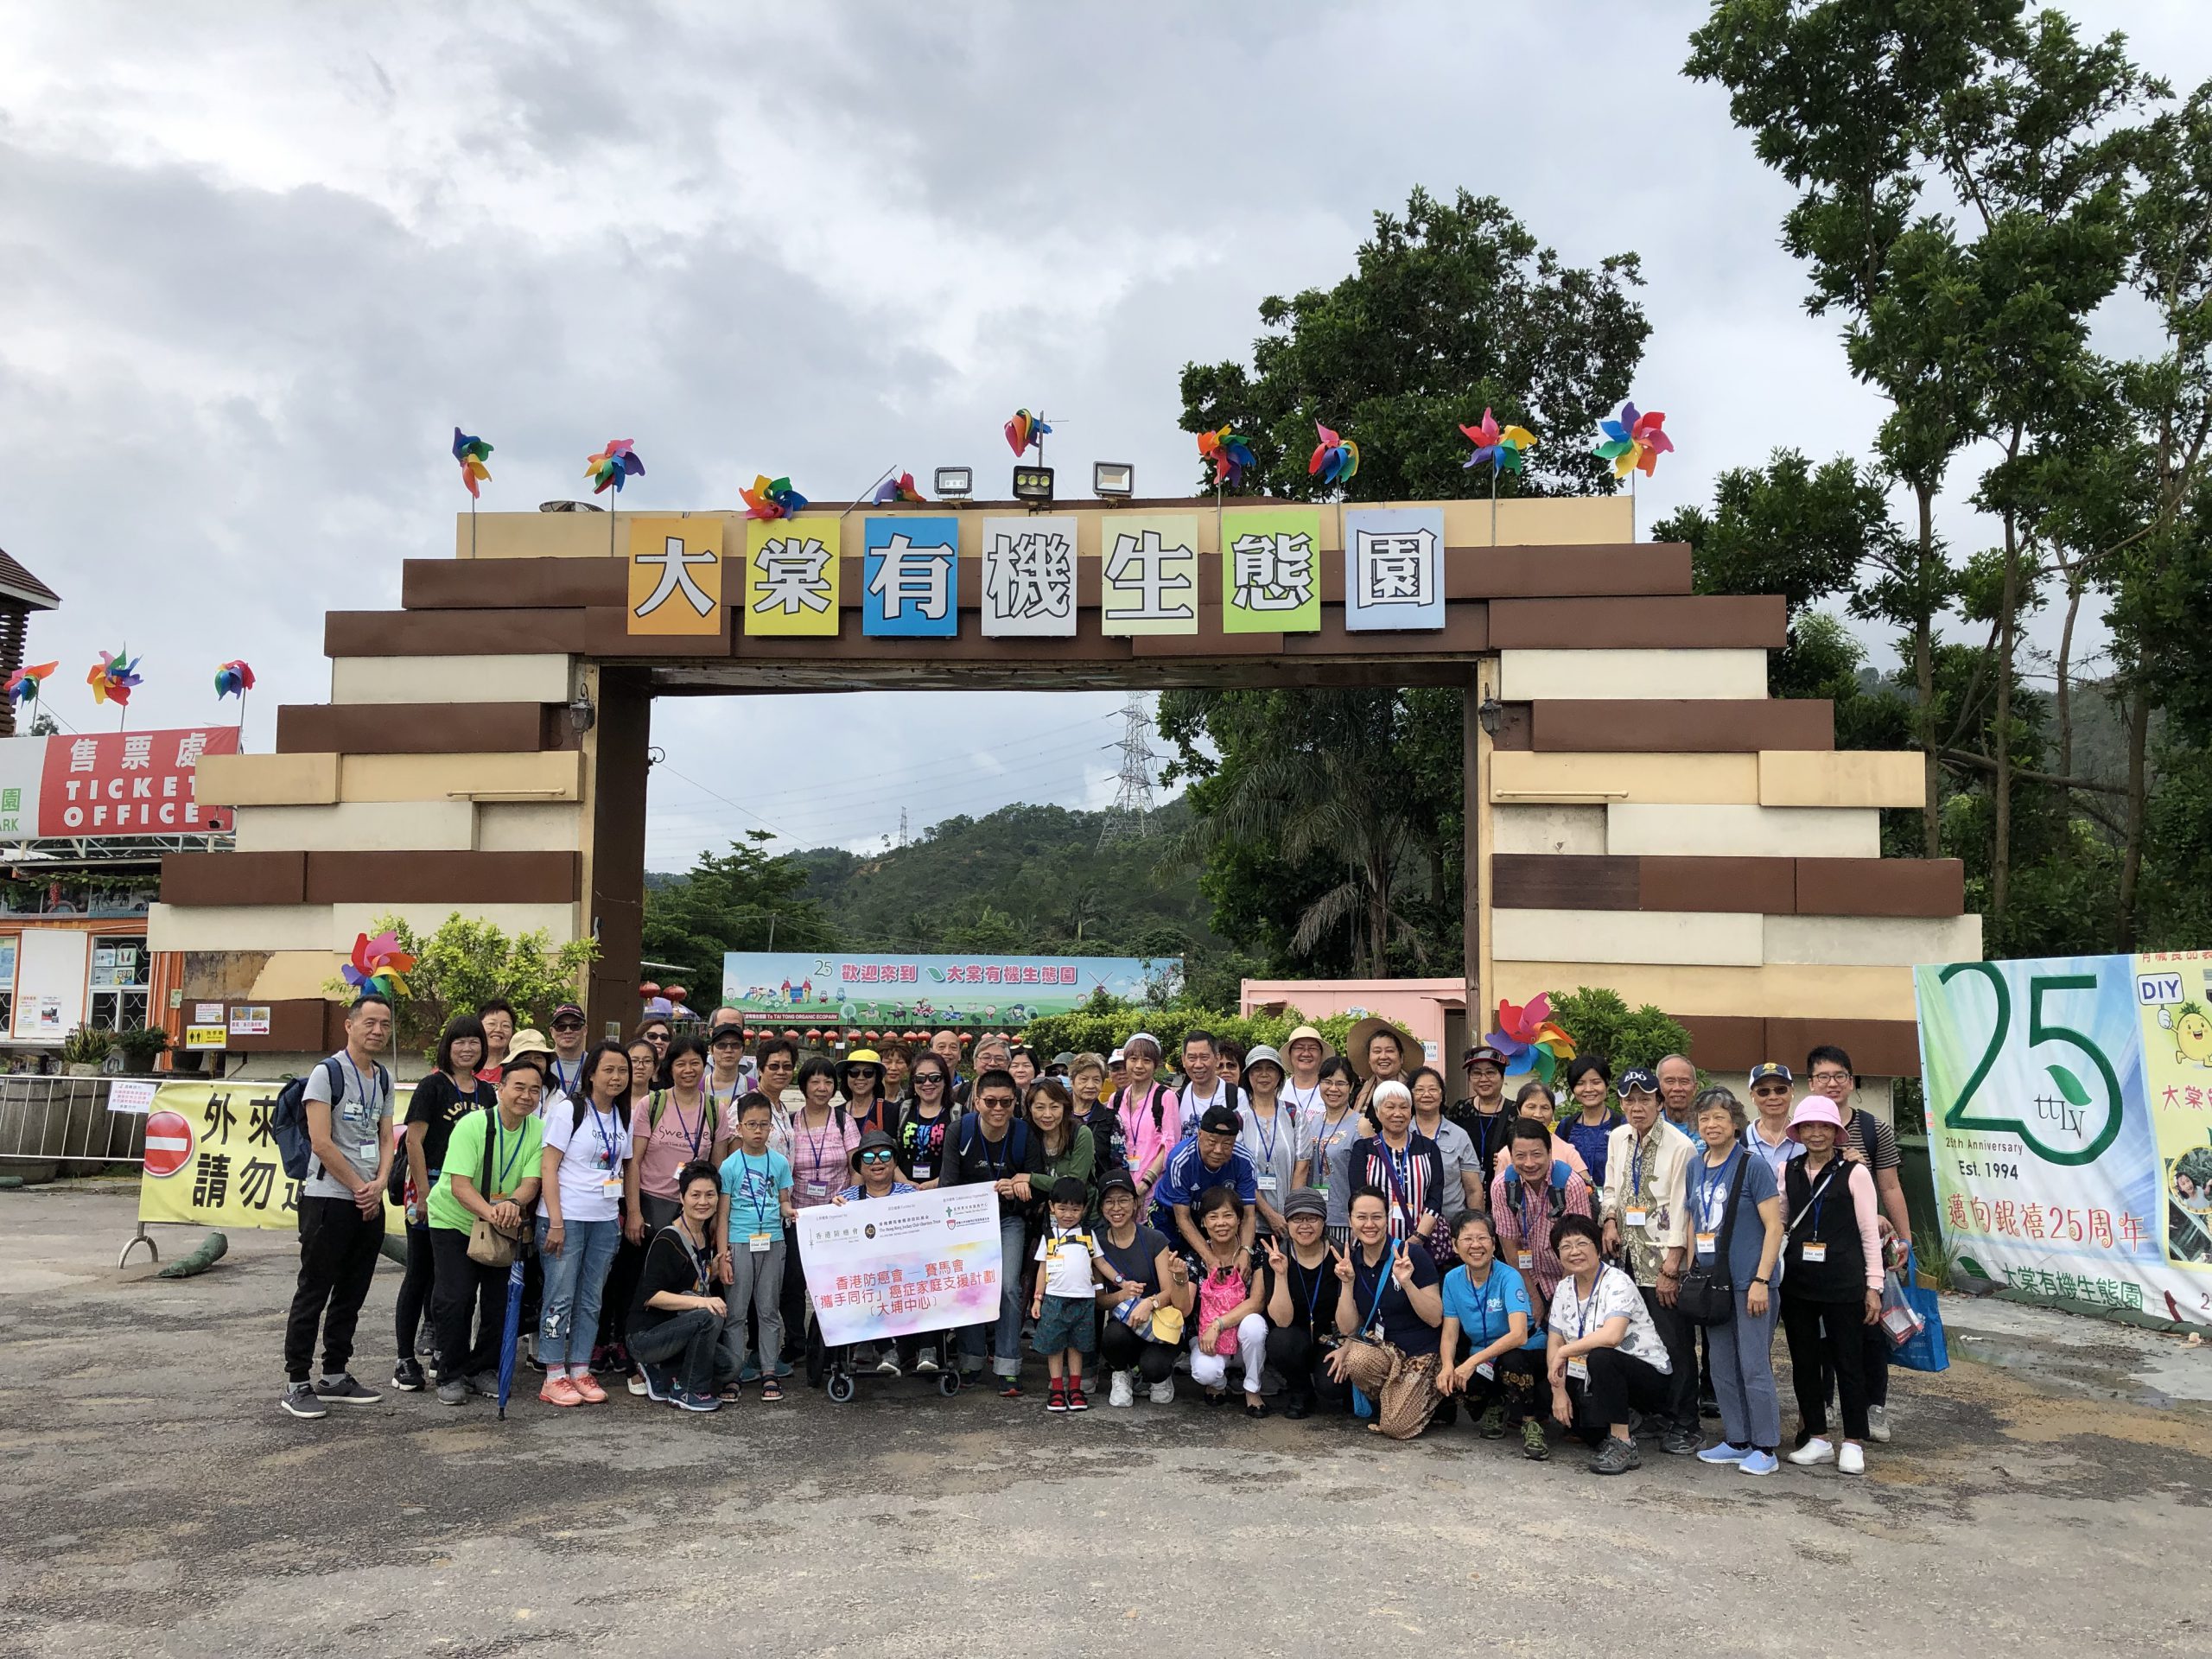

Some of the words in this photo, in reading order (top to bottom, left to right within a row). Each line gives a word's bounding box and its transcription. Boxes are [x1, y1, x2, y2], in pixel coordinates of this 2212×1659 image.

[633, 528, 1436, 620] 大棠有機生態園
[70, 733, 207, 772] 售票處
[1, 787, 21, 812] 園
[64, 802, 199, 827] OFFICE
[814, 960, 833, 977] 25
[841, 963, 918, 982] 歡迎來到
[946, 964, 1078, 984] 大棠有機生態園
[2142, 979, 2180, 1000] DIY
[1938, 962, 2123, 1166] 25
[1945, 1136, 1964, 1149] 25th
[1967, 1137, 2024, 1155] Anniversary
[1958, 1160, 1981, 1178] Est.
[1985, 1161, 2019, 1180] 1994
[816, 1228, 858, 1240] 香港防癌會
[1948, 1192, 2149, 1253] 邁向銀禧25周年
[836, 1268, 904, 1291] 香港防癌會
[925, 1259, 964, 1278] 賽馬會
[2002, 1262, 2144, 1311] 大棠有機生態園
